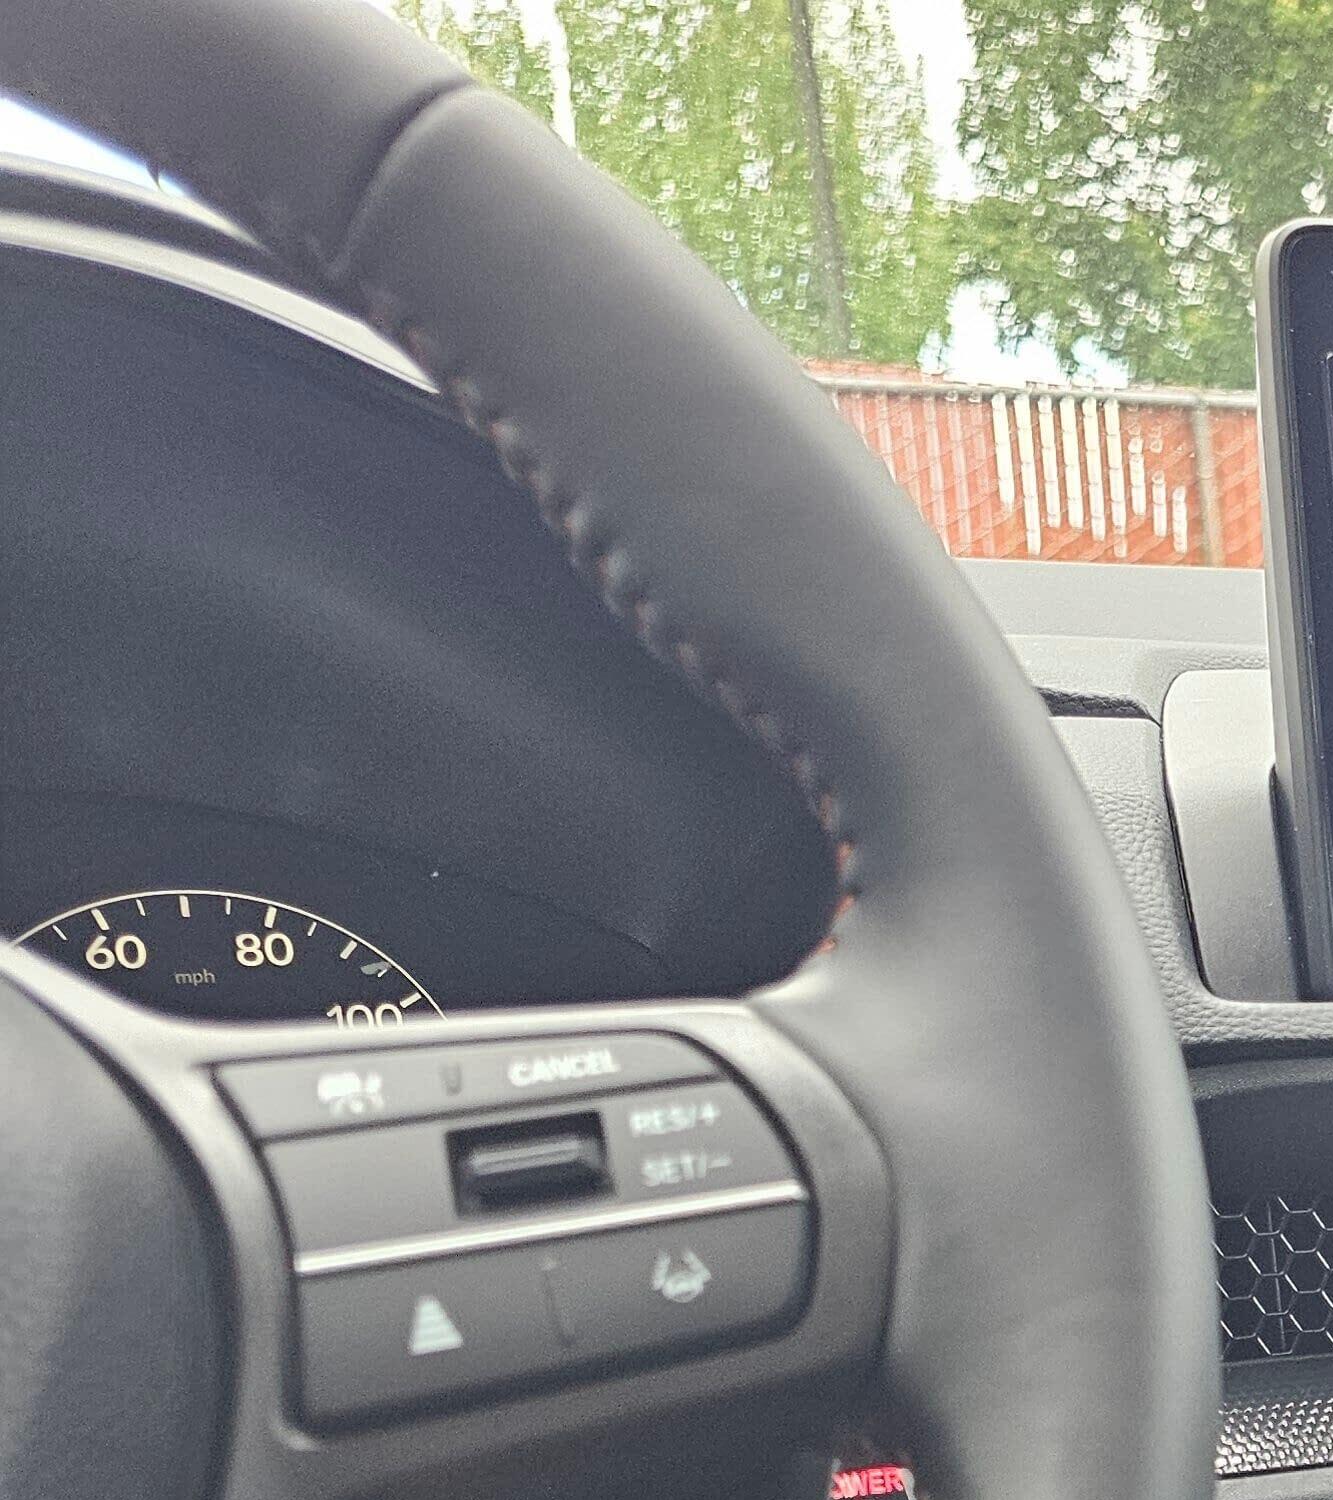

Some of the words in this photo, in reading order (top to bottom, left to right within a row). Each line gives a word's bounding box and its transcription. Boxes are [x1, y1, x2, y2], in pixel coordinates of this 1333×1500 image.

[84, 934, 148, 970] 60
[234, 932, 295, 968] 80
[174, 968, 217, 986] mph
[325, 1003, 404, 1030] 100
[508, 1047, 622, 1087] CANCEL
